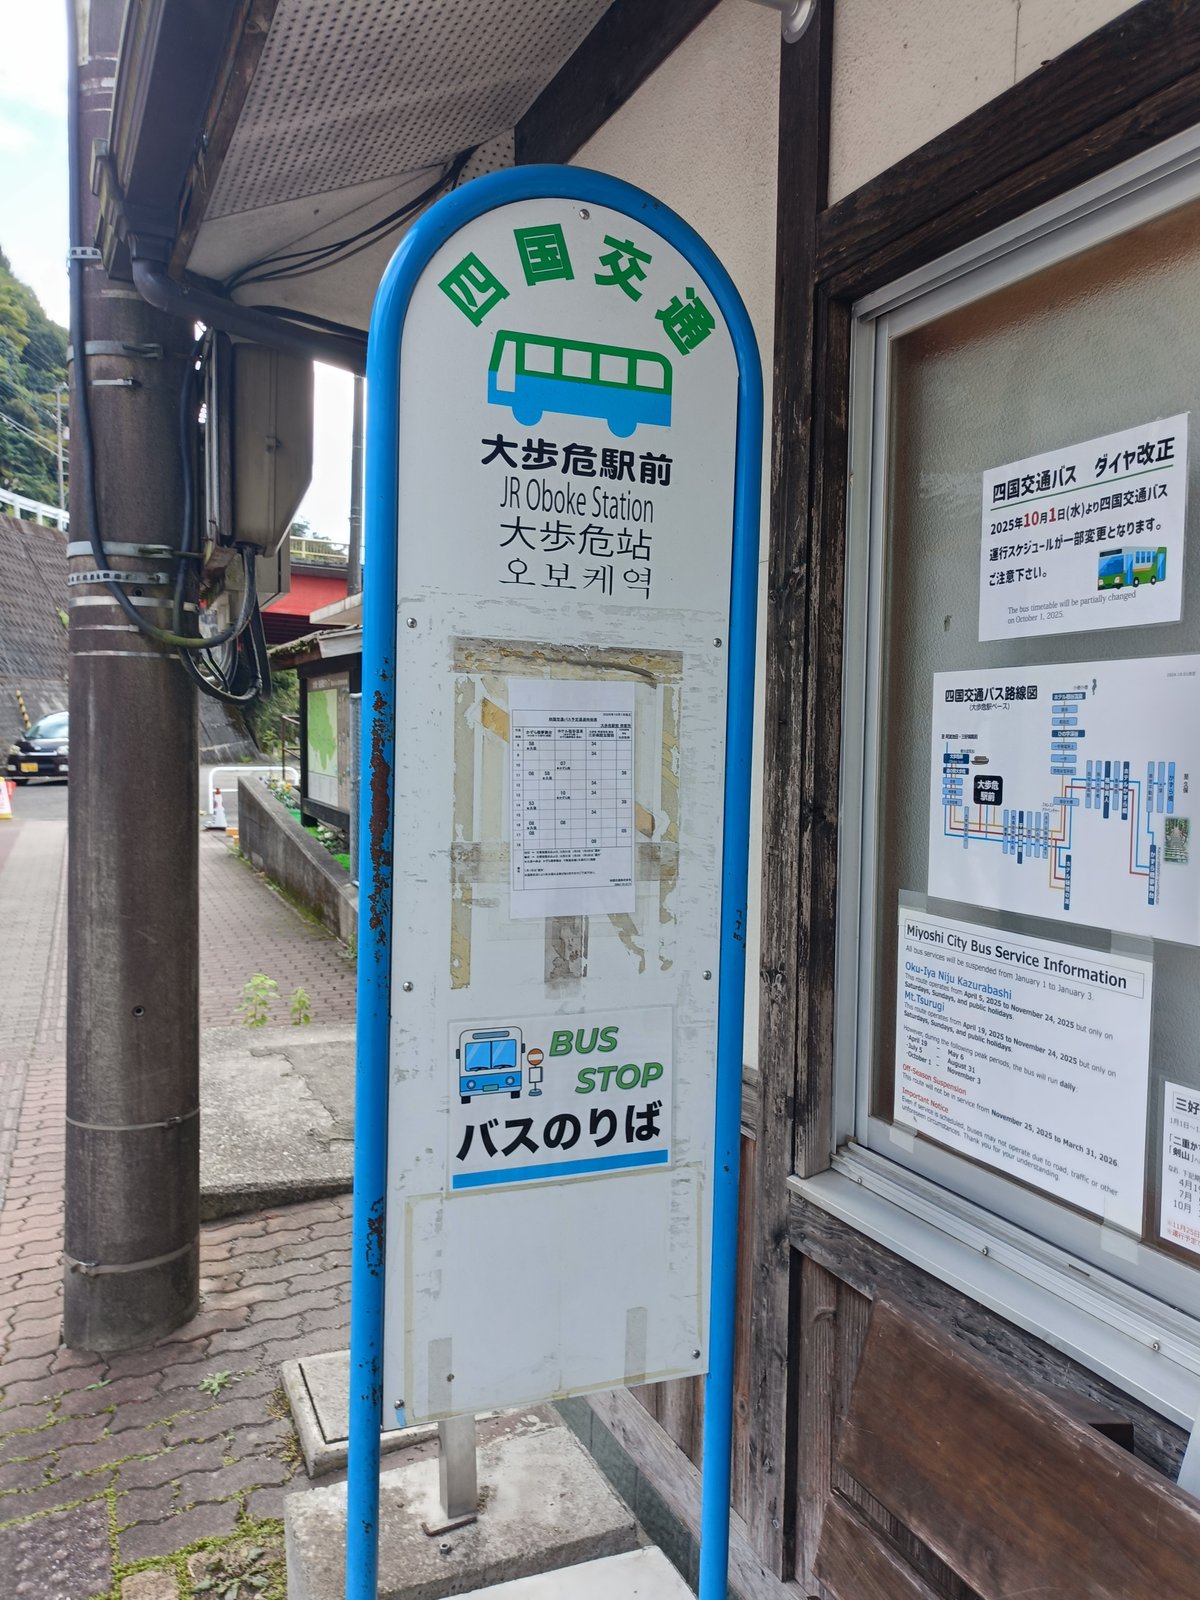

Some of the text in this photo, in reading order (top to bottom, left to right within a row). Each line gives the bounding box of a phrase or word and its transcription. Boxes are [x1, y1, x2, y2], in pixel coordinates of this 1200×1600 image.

[437, 223, 716, 356] 四国交通
[481, 433, 673, 486] 大歩危駅前
[992, 437, 1175, 504] 四国交通バス ダイヤ改正
[500, 476, 654, 524] JR Oboke Station
[990, 484, 1168, 536] 2025年10月1日(水)より四国交通バス
[499, 515, 653, 562] 大歩危站
[989, 517, 1162, 562] 運行スケジュールが一部変更となります。
[498, 557, 652, 600] 오보케역
[988, 567, 1048, 587] ご注意下さい。
[1008, 590, 1136, 615] The bus timetable will be partially changed
[1015, 613, 1038, 624] October
[945, 685, 1038, 702] 四国交通バス路線図
[977, 780, 999, 790] 大歩危
[980, 791, 995, 802] 駅前
[907, 924, 1127, 989] Miyoshi City Bus Service Information
[913, 947, 923, 956] bus
[923, 950, 945, 962] services
[946, 956, 956, 964] will
[965, 961, 997, 975] suspended
[998, 969, 1014, 979] from
[1015, 973, 1041, 988] January
[1048, 982, 1056, 990] to
[1057, 984, 1085, 999] January
[904, 981, 930, 995] Saturdays,
[932, 989, 956, 1003] Sundays,
[968, 1001, 986, 1012] public
[905, 961, 1012, 999] Oku-Iya Niju Kazurabashi
[903, 1010, 930, 1025] Saturdays,
[930, 1019, 955, 1033] Sundays,
[967, 1032, 985, 1043] public
[915, 976, 928, 984] route
[928, 981, 949, 992] operates
[950, 987, 963, 995] from
[963, 991, 978, 1001] April
[986, 997, 1002, 1007] 2025
[1003, 1001, 1010, 1009] to
[1010, 1004, 1043, 1019] November
[1045, 1014, 1055, 1024] 24,
[1057, 1017, 1075, 1028] 2025
[1075, 1023, 1087, 1033] but
[1088, 1027, 1103, 1038] only
[1104, 1032, 1113, 1040] on
[549, 1026, 664, 1094] BUS STOP
[904, 1001, 1117, 1077] This route operates from April 19, 2025 to November 24, 2025 but only on
[924, 1032, 940, 1044] during
[941, 1038, 949, 1046] the
[950, 1042, 973, 1055] following
[974, 1051, 988, 1060] peak
[988, 1056, 1011, 1069] periods,
[1012, 1063, 1022, 1072] the
[1023, 1067, 1035, 1076] bus
[1036, 1072, 1047, 1080] will
[1048, 1077, 1058, 1085] run
[947, 1049, 959, 1059] May
[902, 1063, 967, 1095] Off-Season Suspension
[947, 1058, 967, 1070] August
[968, 1065, 975, 1073] 31
[947, 1066, 975, 1082] November
[902, 1087, 949, 1113] Important Notice
[902, 1072, 912, 1081] This
[912, 1077, 925, 1086] route
[925, 1082, 934, 1090] will
[934, 1085, 942, 1093] not
[943, 1089, 950, 1097] be
[957, 1096, 975, 1108] service
[976, 1103, 990, 1113] from
[991, 1109, 1023, 1127] November
[1024, 1122, 1034, 1133] 25,
[1036, 1127, 1053, 1139] 2025
[1054, 1135, 1061, 1143] to
[1063, 1138, 1083, 1153] March
[1086, 1147, 1097, 1159] 31,
[456, 1100, 663, 1161] バスのりば
[901, 1105, 1015, 1160] unforeseen Thank you for your
[917, 1103, 934, 1115] service
[966, 1125, 983, 1138] buses
[984, 1132, 996, 1144] may
[997, 1138, 1007, 1147] not
[1008, 1143, 1031, 1158] operate
[1032, 1153, 1043, 1164] due
[1044, 1159, 1051, 1167] to
[1053, 1162, 1069, 1175] road,
[1070, 1170, 1090, 1184] traffic
[1100, 1184, 1119, 1196] other
